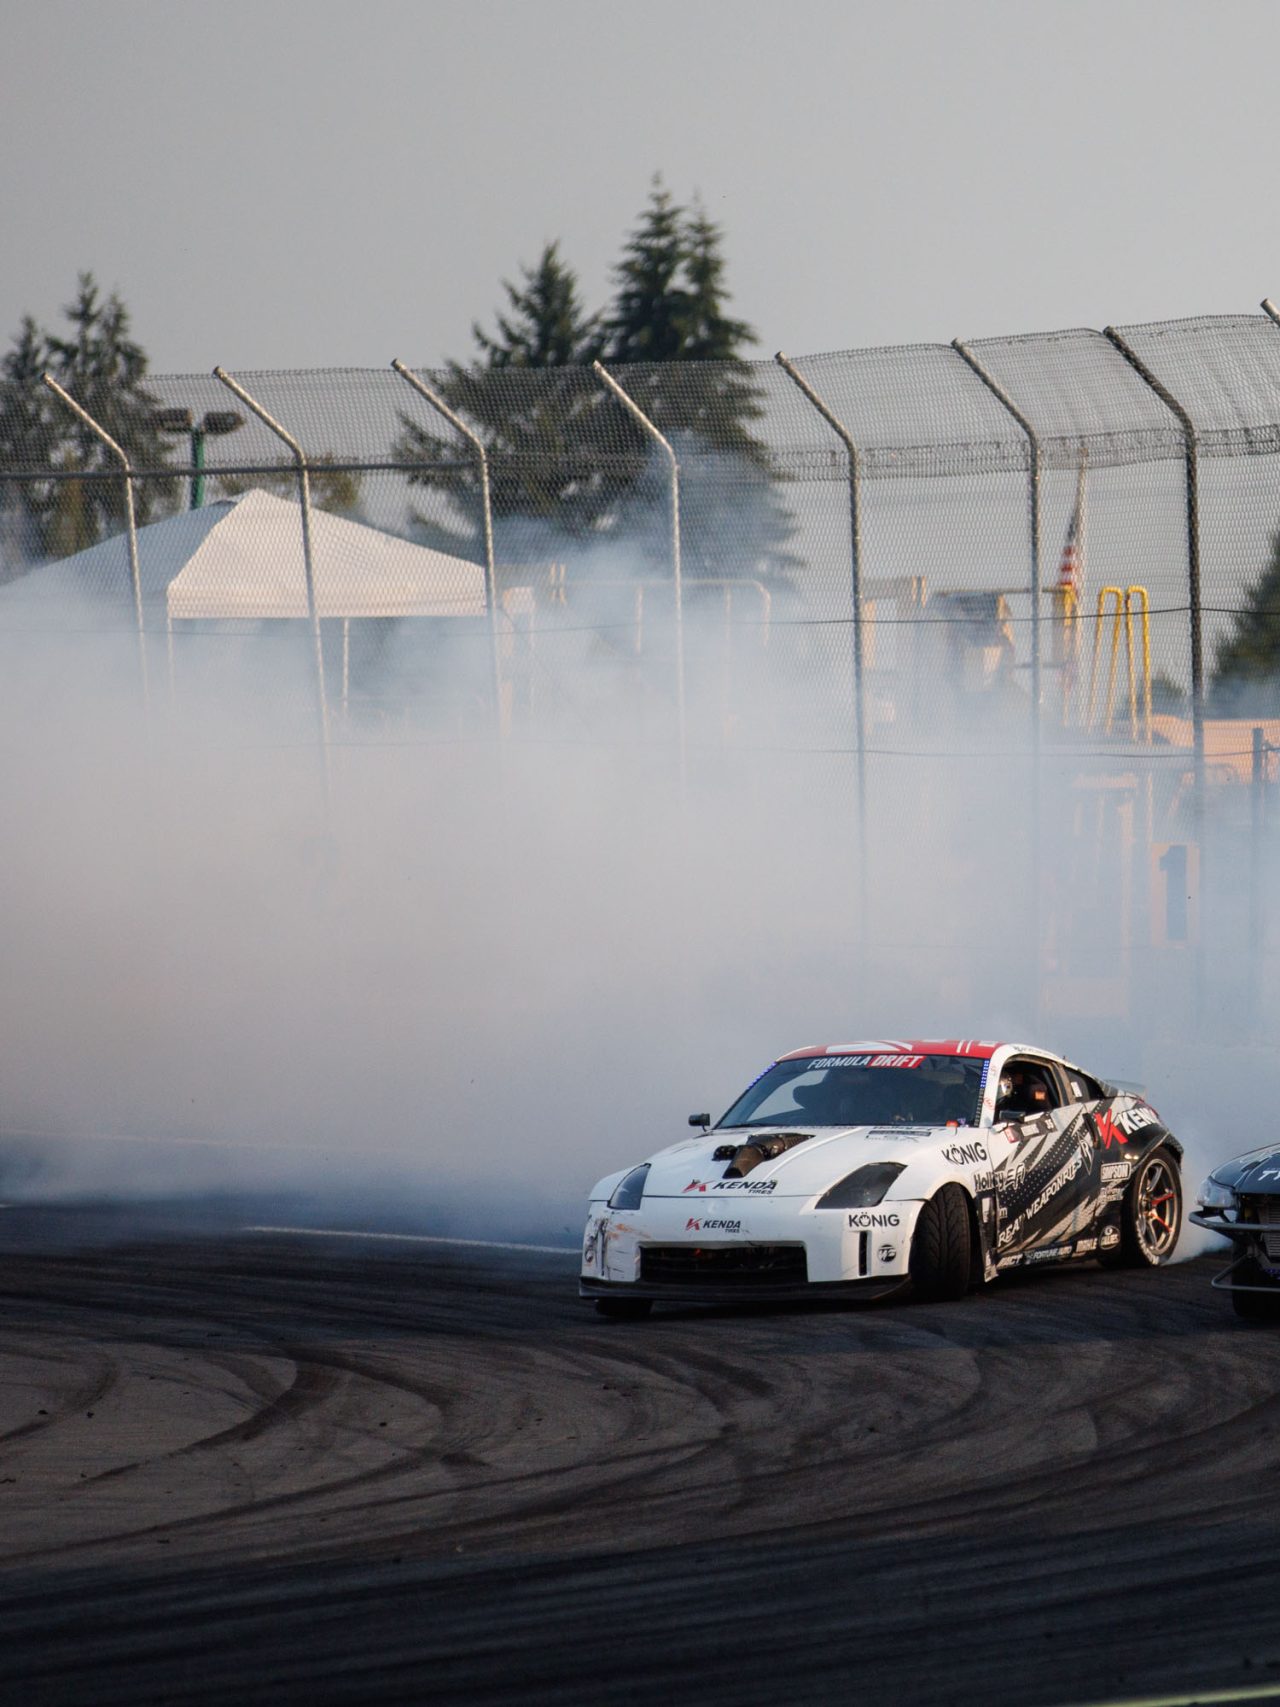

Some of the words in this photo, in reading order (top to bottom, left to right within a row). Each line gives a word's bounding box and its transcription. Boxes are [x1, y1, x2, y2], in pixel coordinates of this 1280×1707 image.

[807, 1055, 872, 1070] FORMULA
[870, 1055, 923, 1067] DRIFT
[941, 1142, 987, 1165] KÖNIG
[712, 1181, 778, 1190] KENDA
[702, 1220, 741, 1229] KENDA
[848, 1211, 900, 1228] KÖNIG
